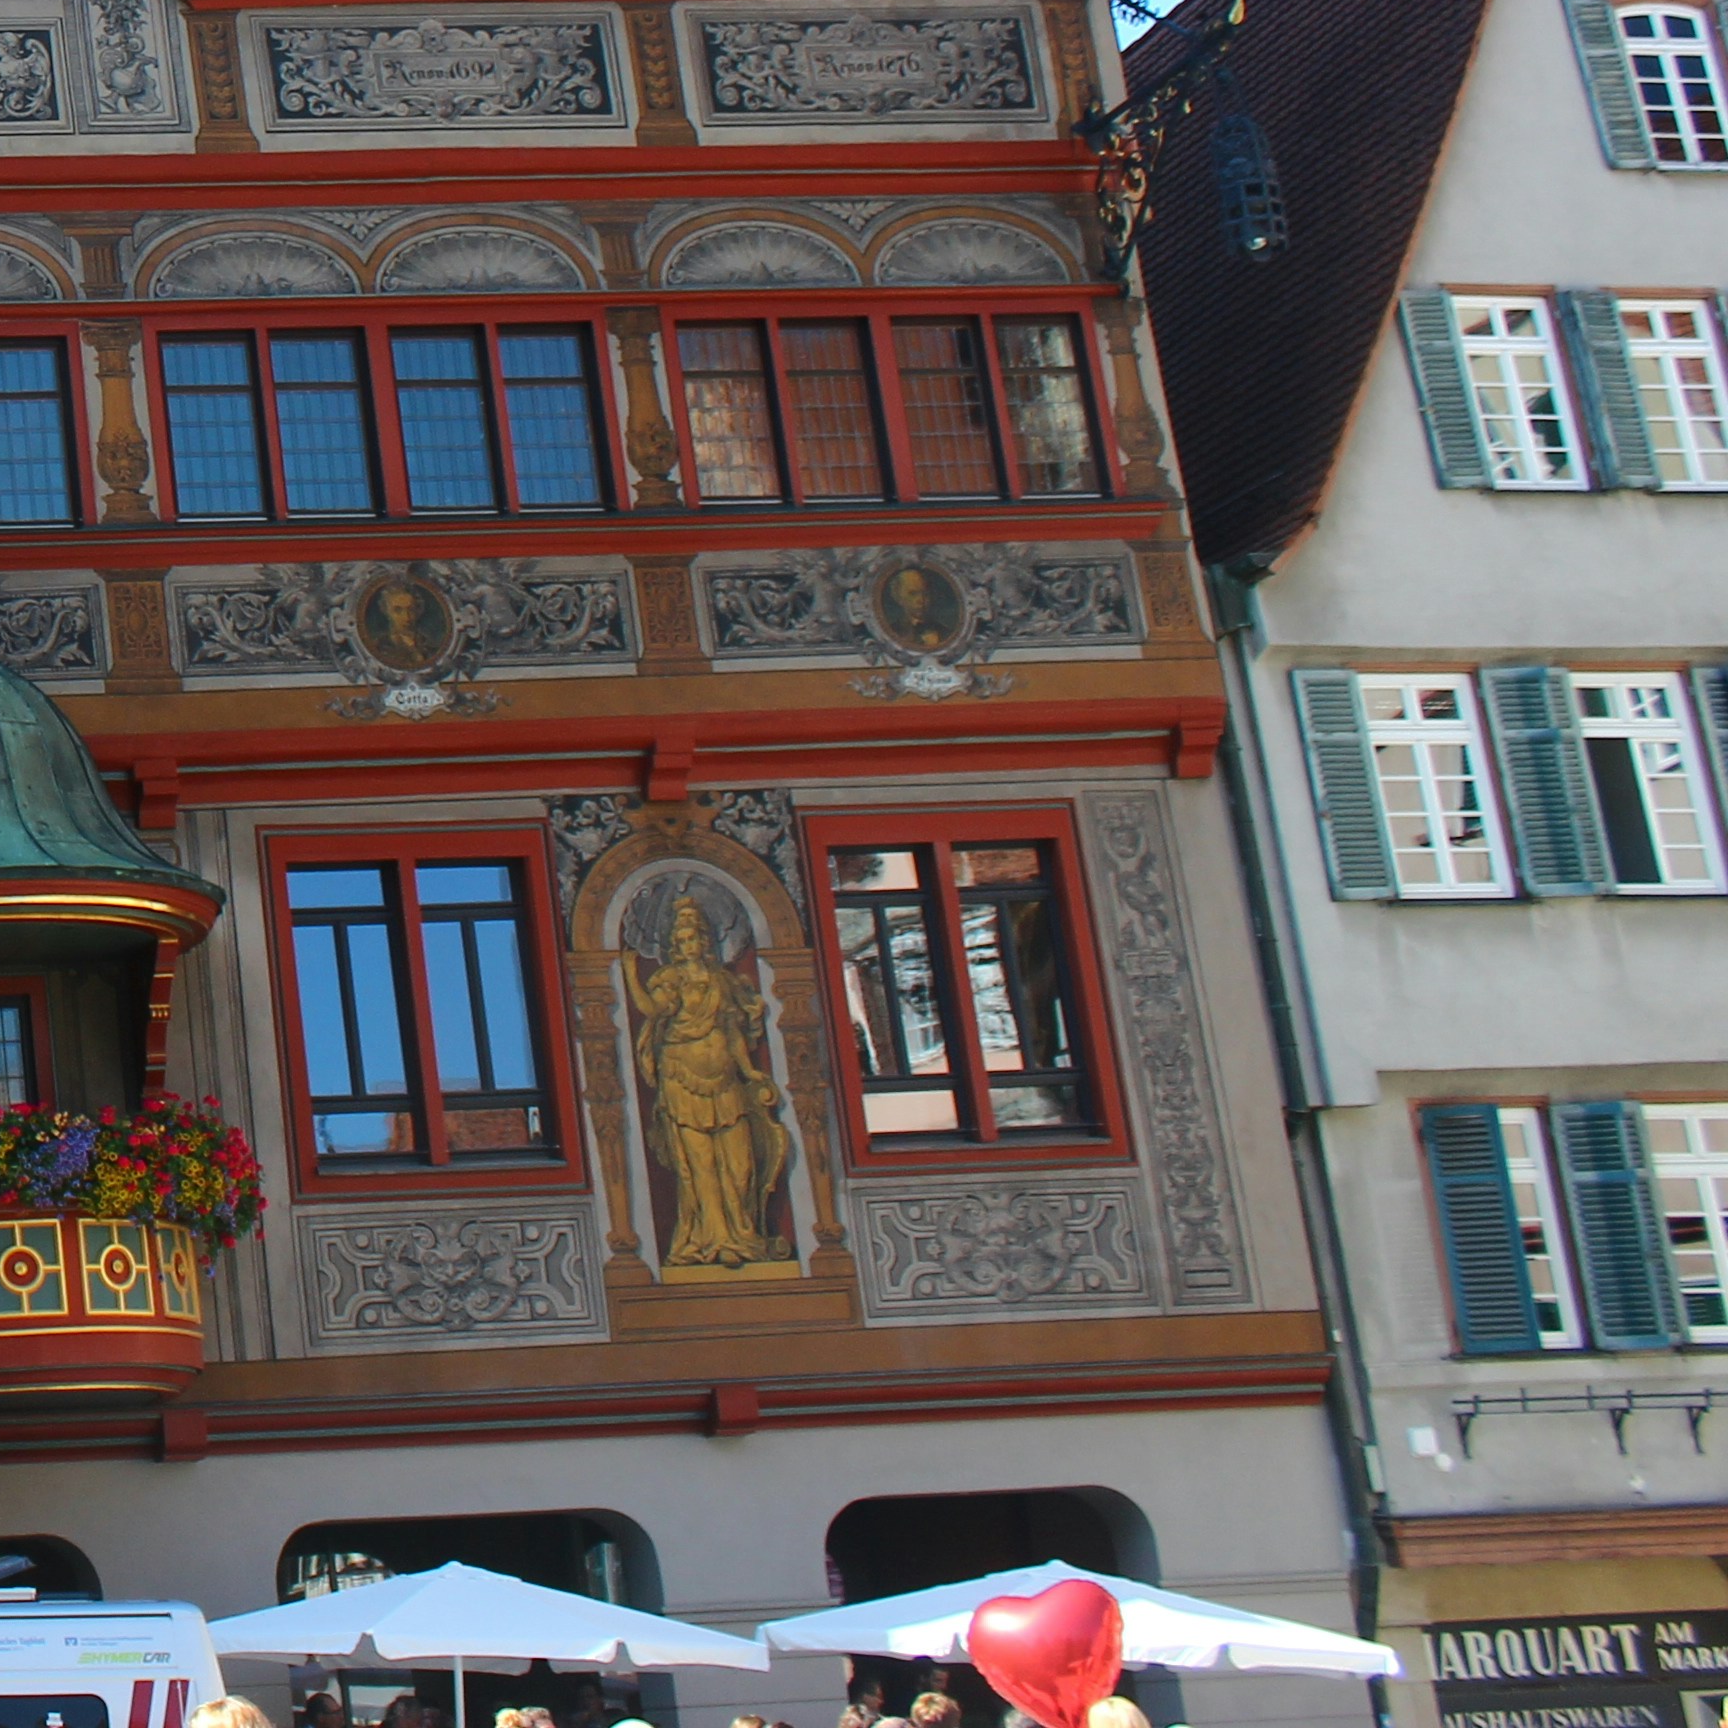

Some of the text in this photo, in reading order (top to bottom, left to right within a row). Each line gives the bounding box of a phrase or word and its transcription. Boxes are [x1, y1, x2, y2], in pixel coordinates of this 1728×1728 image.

[1654, 1622, 1695, 1645] AM
[1657, 1646, 1728, 1671] MARK
[1443, 1705, 1661, 1728] AUSHALTSWAREN
